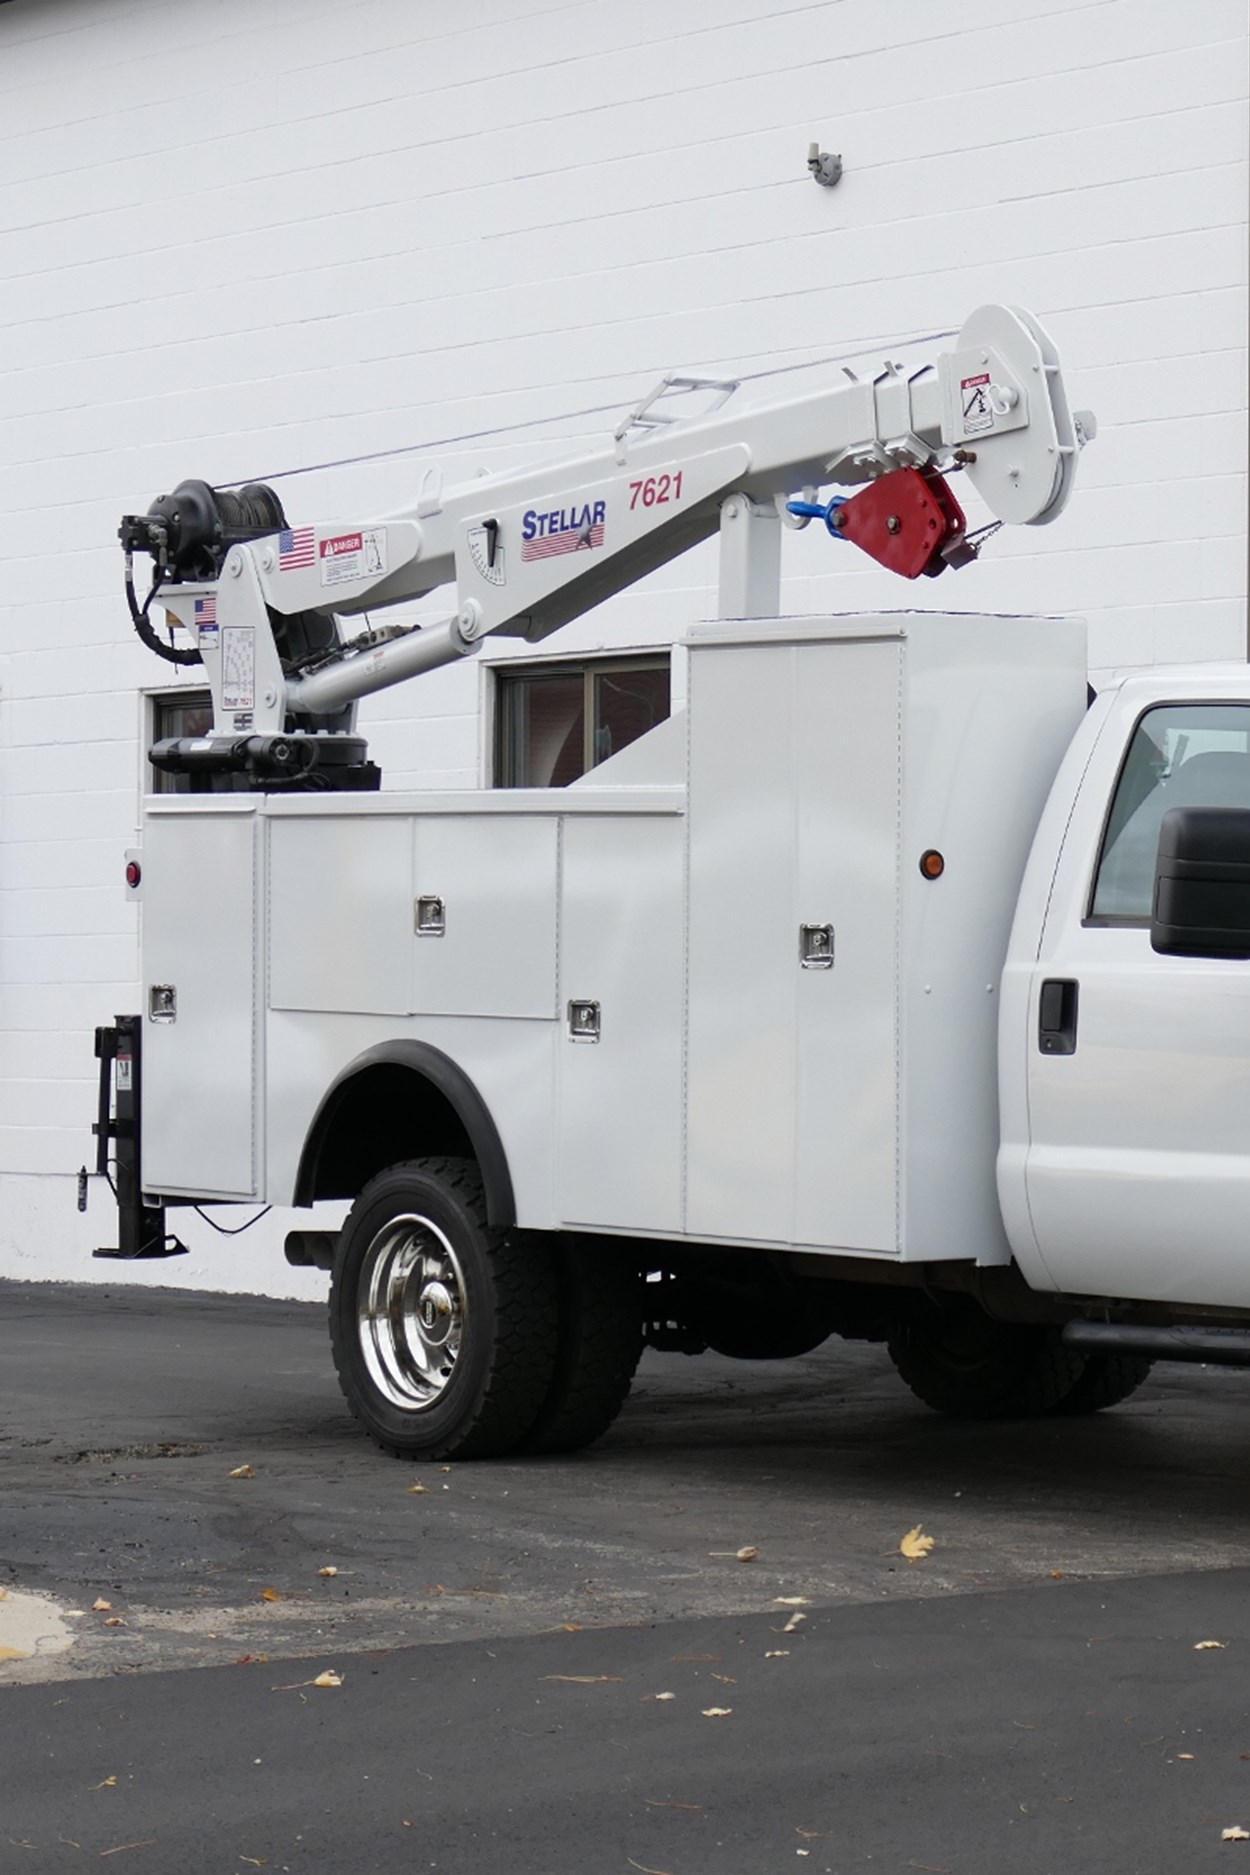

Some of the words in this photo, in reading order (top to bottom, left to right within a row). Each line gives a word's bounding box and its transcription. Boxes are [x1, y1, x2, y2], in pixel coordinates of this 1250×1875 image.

[629, 471, 682, 510] 7621
[522, 500, 606, 540] STELLAR
[333, 538, 361, 554] DANGER
